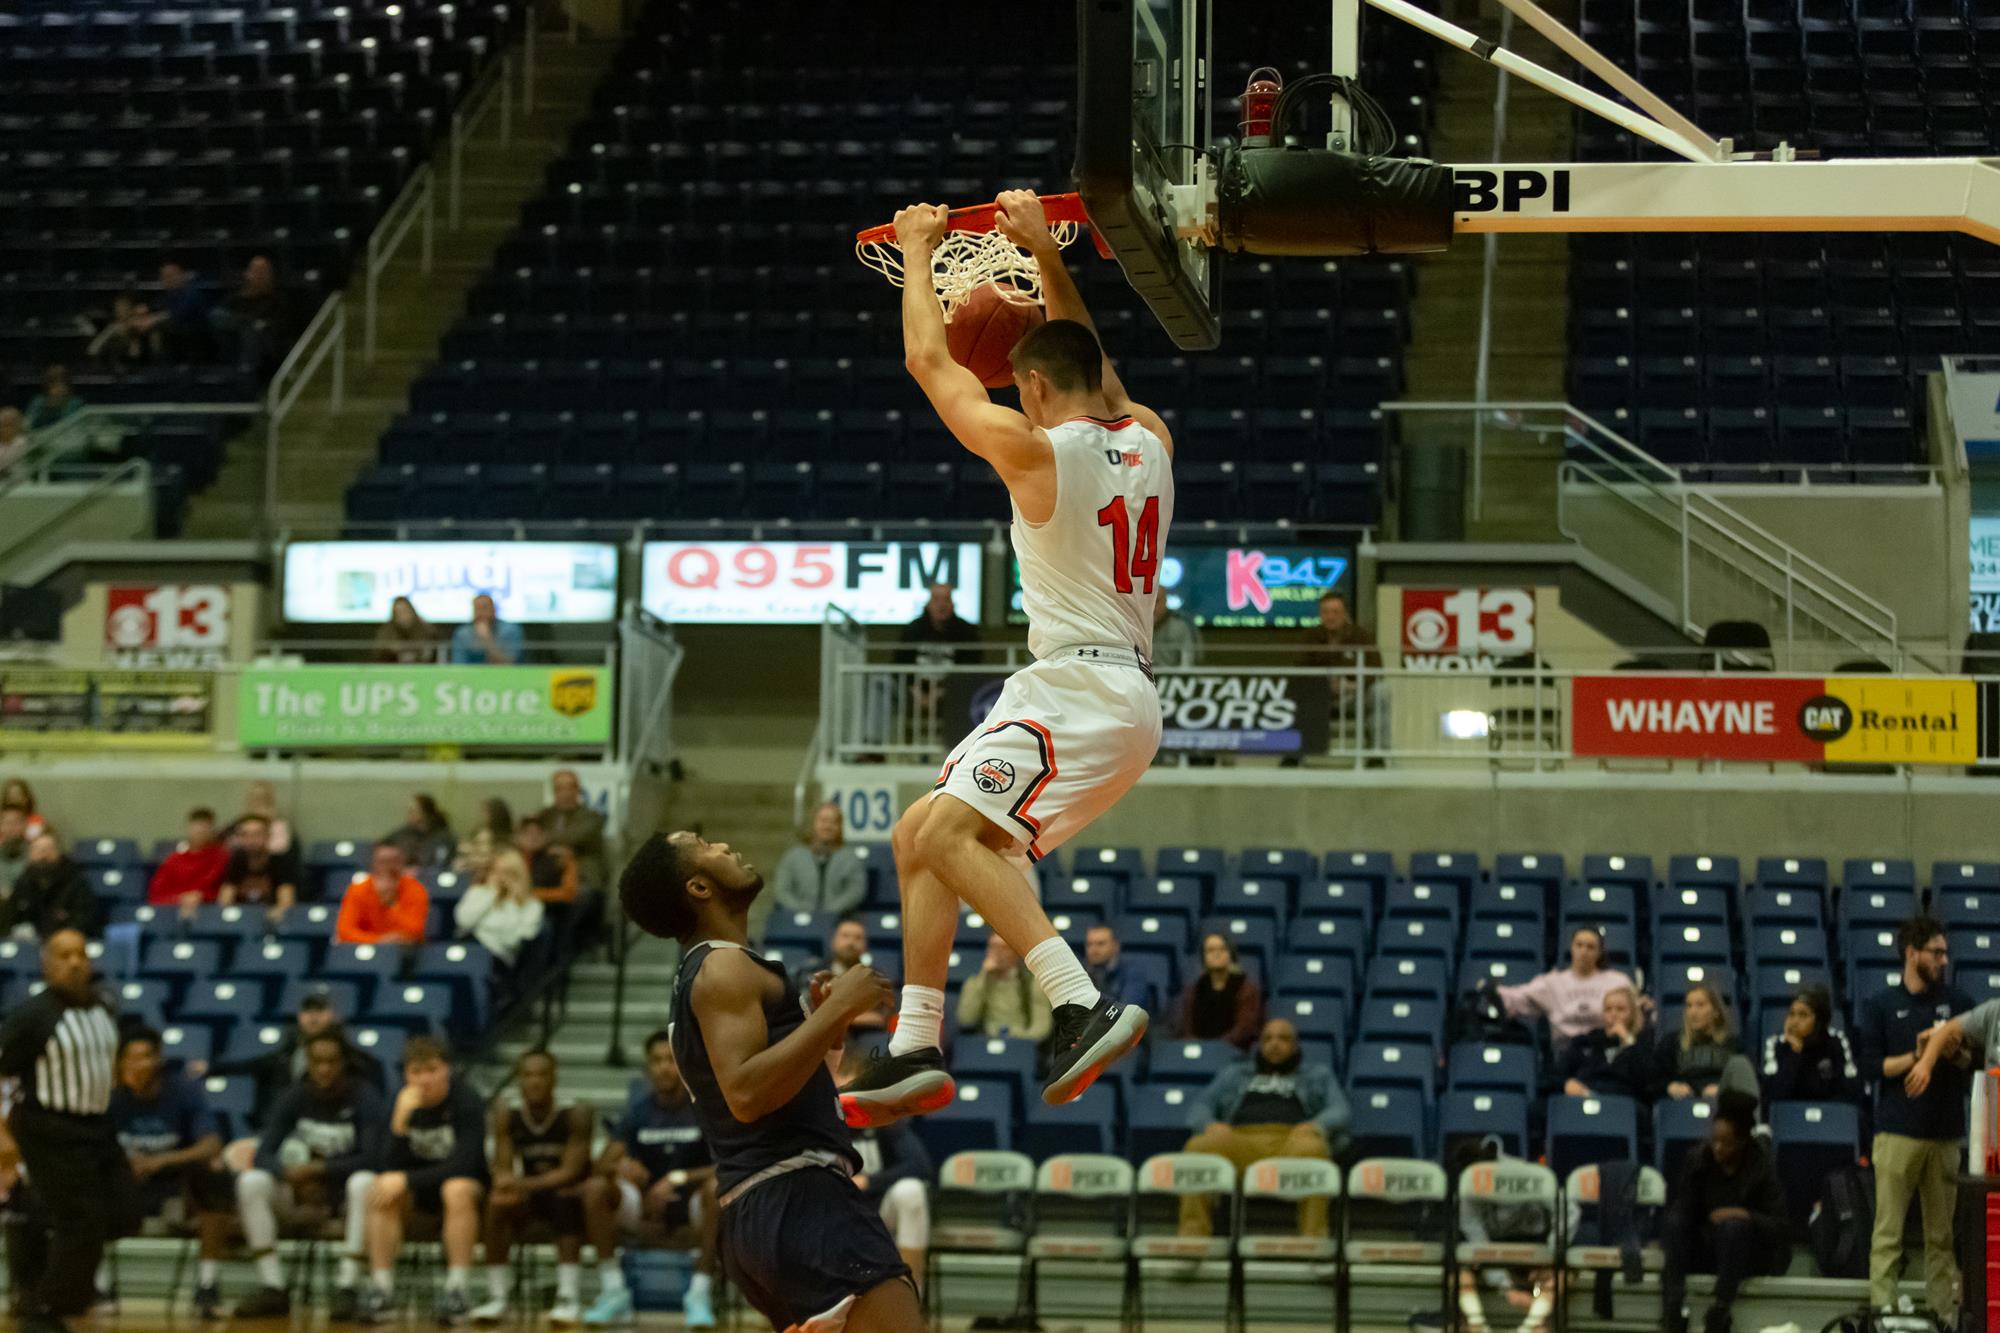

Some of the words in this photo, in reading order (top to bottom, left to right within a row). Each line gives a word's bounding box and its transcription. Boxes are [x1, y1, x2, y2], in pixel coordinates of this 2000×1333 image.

[1454, 170, 1570, 212] BPI
[1097, 495, 1159, 594] 14
[144, 585, 228, 648] 13
[1443, 588, 1534, 656] 13
[255, 682, 325, 716] The
[340, 682, 420, 716] UPS
[435, 682, 540, 716] Store
[1606, 698, 1775, 734] WHAYNE
[1804, 706, 1844, 731] CAT
[1858, 709, 1959, 733] Rental
